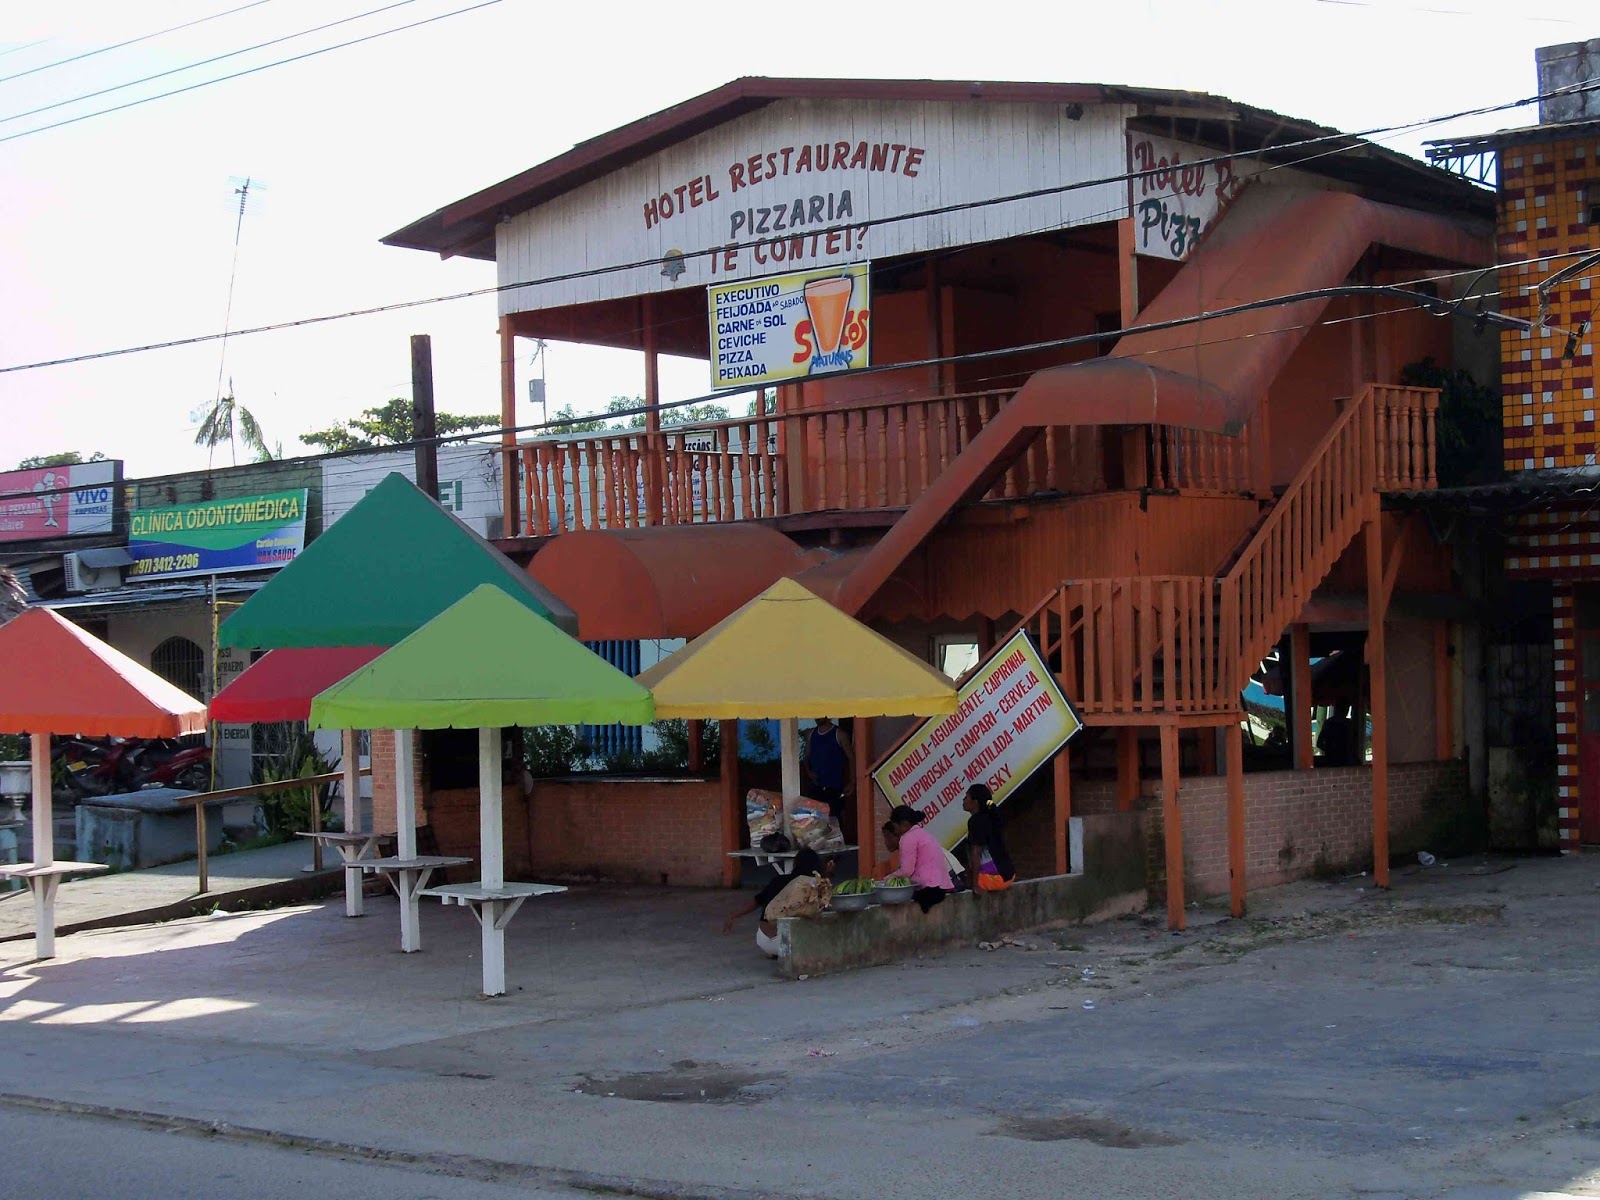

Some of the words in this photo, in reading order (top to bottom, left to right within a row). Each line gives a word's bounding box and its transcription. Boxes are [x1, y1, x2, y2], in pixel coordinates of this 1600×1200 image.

[1135, 140, 1206, 197] Hotel
[643, 174, 720, 230] HOTEL
[728, 141, 925, 193] RESTAURANTE
[730, 189, 853, 239] PIZZARIA
[709, 242, 741, 274] TE
[754, 223, 869, 265] CONTEI?
[716, 284, 780, 305] EXECUTIVO
[716, 301, 772, 320] FEIJOADA
[780, 296, 804, 310] SABADO
[717, 319, 755, 335] CARNE
[763, 314, 787, 328] SOL
[718, 332, 767, 350] CEVICHE
[718, 349, 754, 366] PIZZA
[719, 363, 767, 381] PEIXADA
[75, 488, 108, 504] VIVO
[75, 505, 107, 515] EMPRESAS
[131, 510, 183, 536] CLÍNICA
[186, 496, 299, 529] ODONTOMÉDICA
[888, 742, 932, 789] AMARULA
[983, 649, 1027, 696] CAIPIRINHA
[900, 754, 954, 808] CAIPIROSKA
[954, 710, 998, 758] CAMPARI
[998, 670, 1040, 715] CERVEJA
[936, 776, 965, 808] LIBRE
[963, 729, 1015, 783] MENTILADA
[1012, 690, 1054, 736] MARTINI
